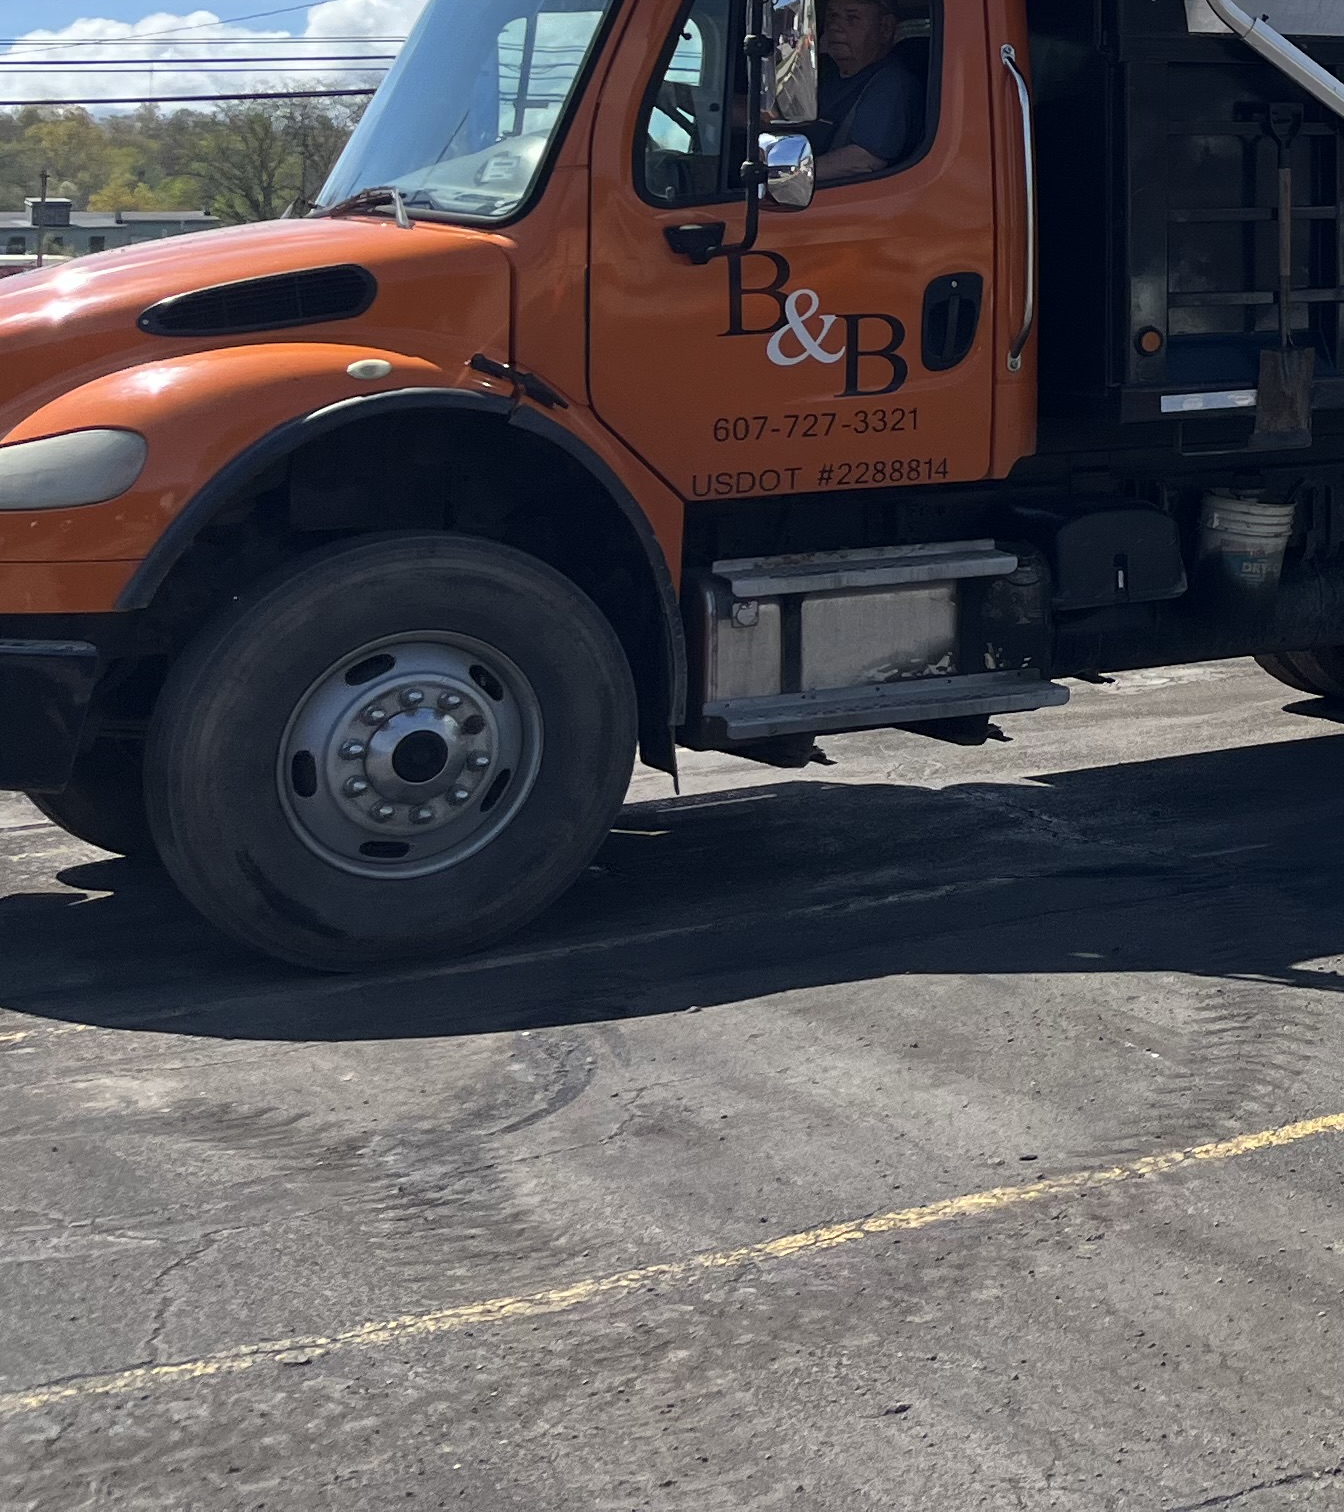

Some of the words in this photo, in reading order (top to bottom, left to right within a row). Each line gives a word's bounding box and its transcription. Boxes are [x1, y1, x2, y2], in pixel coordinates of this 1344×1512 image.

[716, 250, 908, 398] B&B
[713, 407, 918, 441] 607-727-3321
[692, 467, 803, 497] USDOT
[817, 457, 949, 486] #2288814
